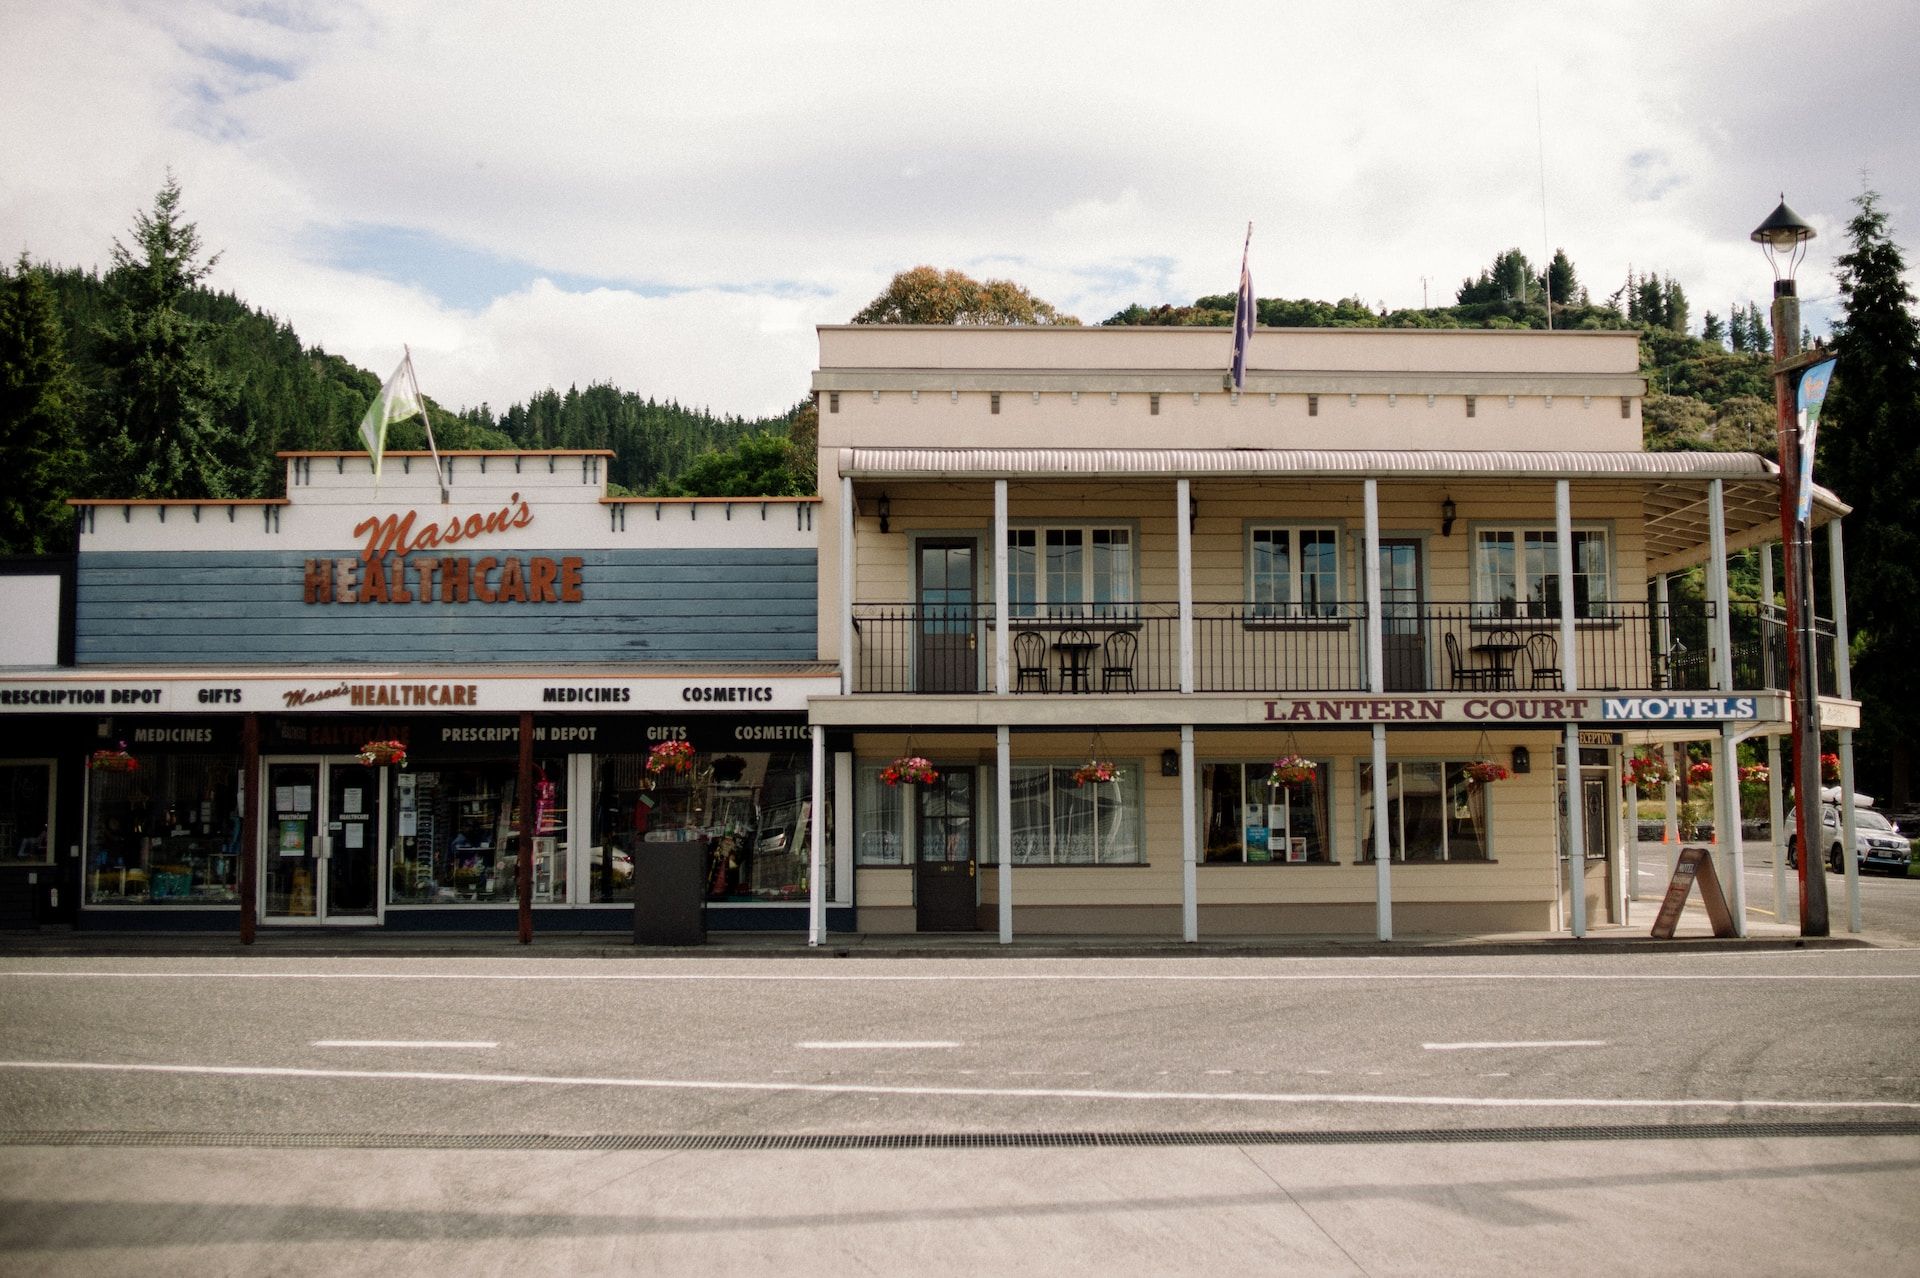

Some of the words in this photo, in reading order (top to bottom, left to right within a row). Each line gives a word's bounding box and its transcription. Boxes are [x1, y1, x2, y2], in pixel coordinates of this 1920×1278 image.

[353, 492, 535, 562] Mason's
[303, 557, 584, 604] HEALTHCARE
[0, 689, 105, 705] RESCRIPTION
[111, 689, 162, 704] DEPOT
[197, 688, 242, 704] GIFTS
[283, 681, 352, 708] Mason's
[351, 684, 477, 706] HEALTHCARE
[543, 687, 631, 703] MEDICINES
[682, 687, 773, 702] COSMETICS
[1264, 699, 1446, 721] LANTERN
[1463, 699, 1589, 720] COURT
[1605, 698, 1755, 719] MOTELS
[135, 728, 213, 743] MEDICINES
[442, 727, 546, 742] PRESCRIPTN
[551, 727, 597, 742] DEPOT
[647, 726, 687, 741] GIFTS
[1579, 732, 1613, 745] ECEPTION
